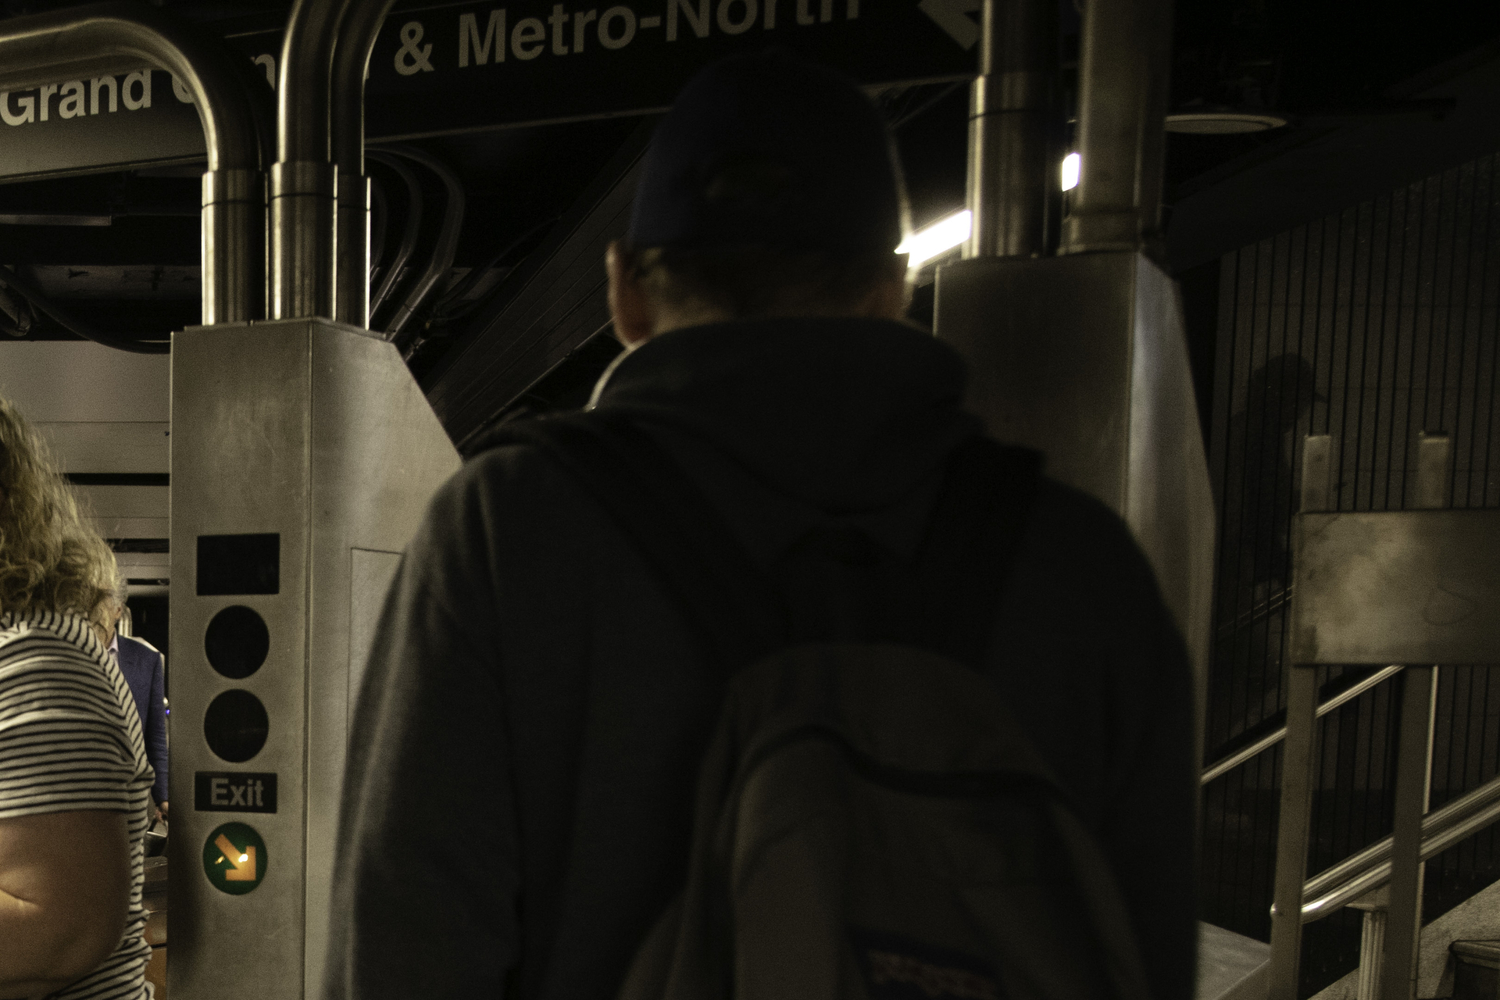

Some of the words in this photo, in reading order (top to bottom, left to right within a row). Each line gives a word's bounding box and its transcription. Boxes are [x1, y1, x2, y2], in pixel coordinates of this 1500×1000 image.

[0, 68, 152, 127] Grand
[393, 21, 435, 77] &
[210, 777, 264, 807] Exit
